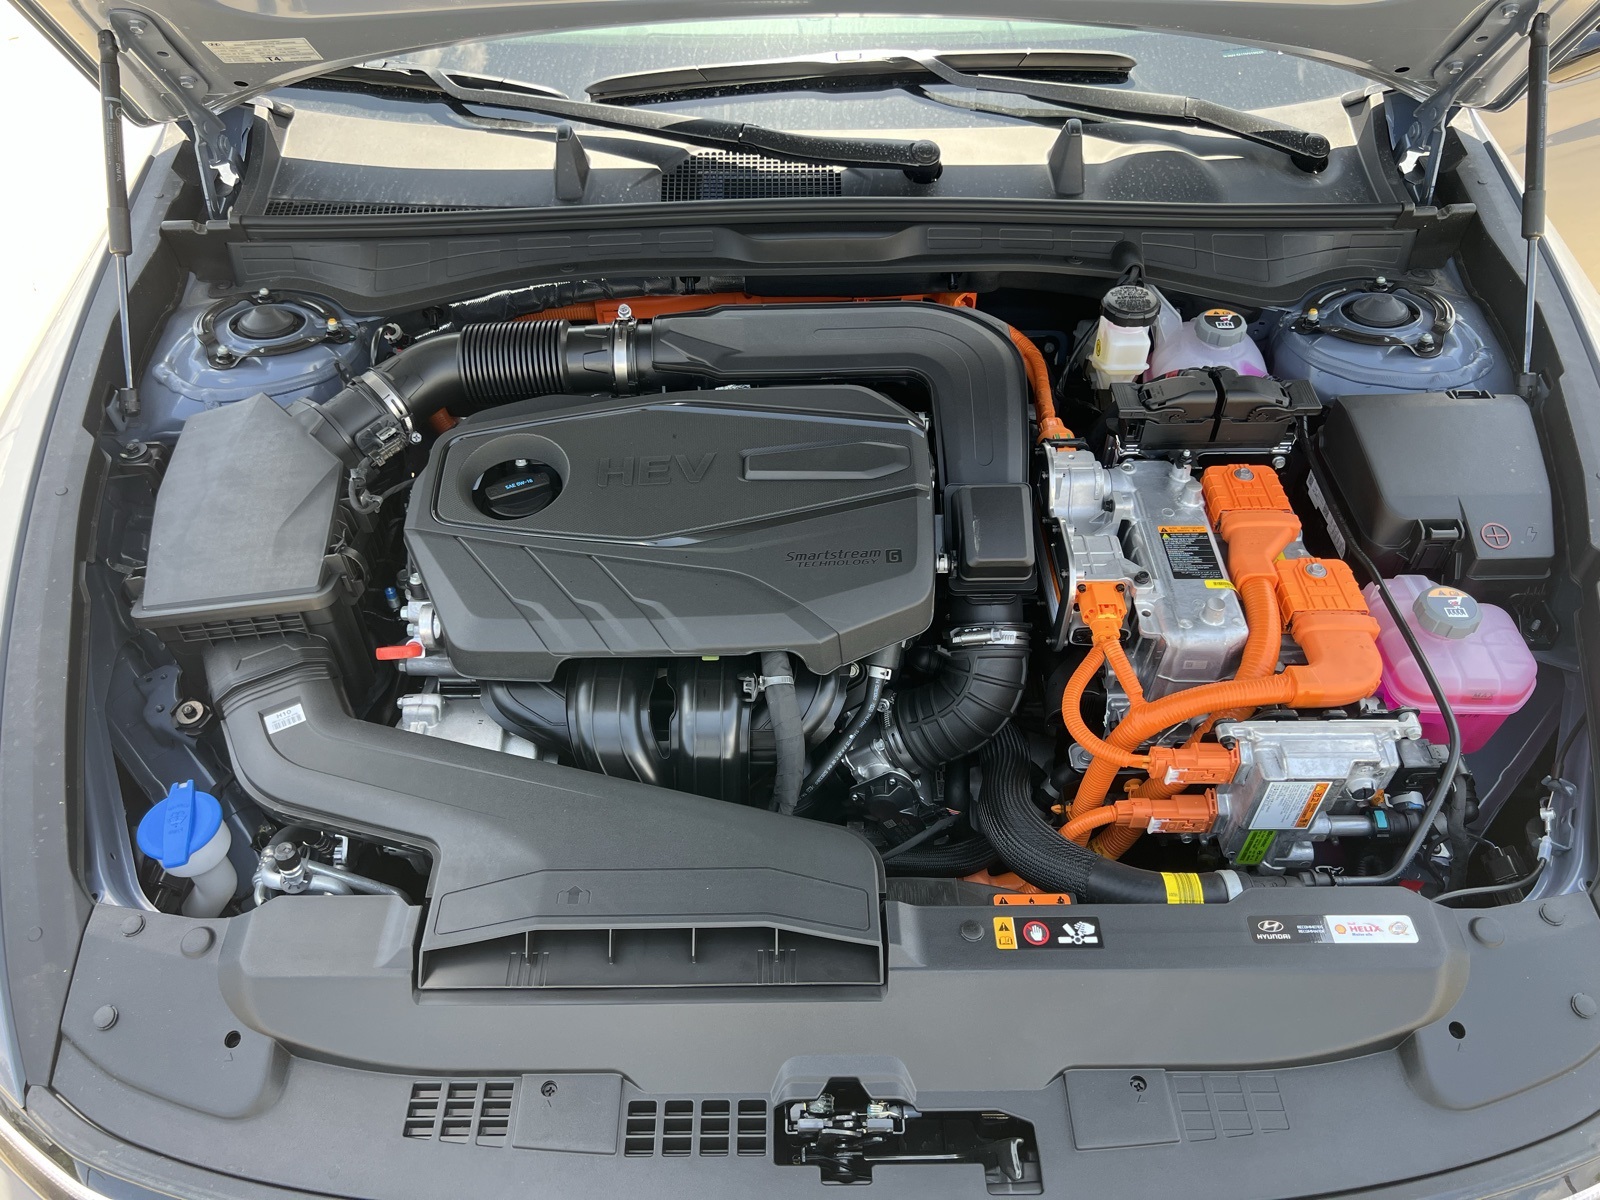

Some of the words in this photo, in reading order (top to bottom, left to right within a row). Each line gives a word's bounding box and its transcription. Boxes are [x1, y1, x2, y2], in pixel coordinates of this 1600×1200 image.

[597, 452, 717, 487] HEV
[786, 549, 881, 561] Smartstream
[887, 550, 901, 562] G
[797, 559, 879, 567] TECHNOLOGY
[1349, 925, 1381, 933] HELIX
